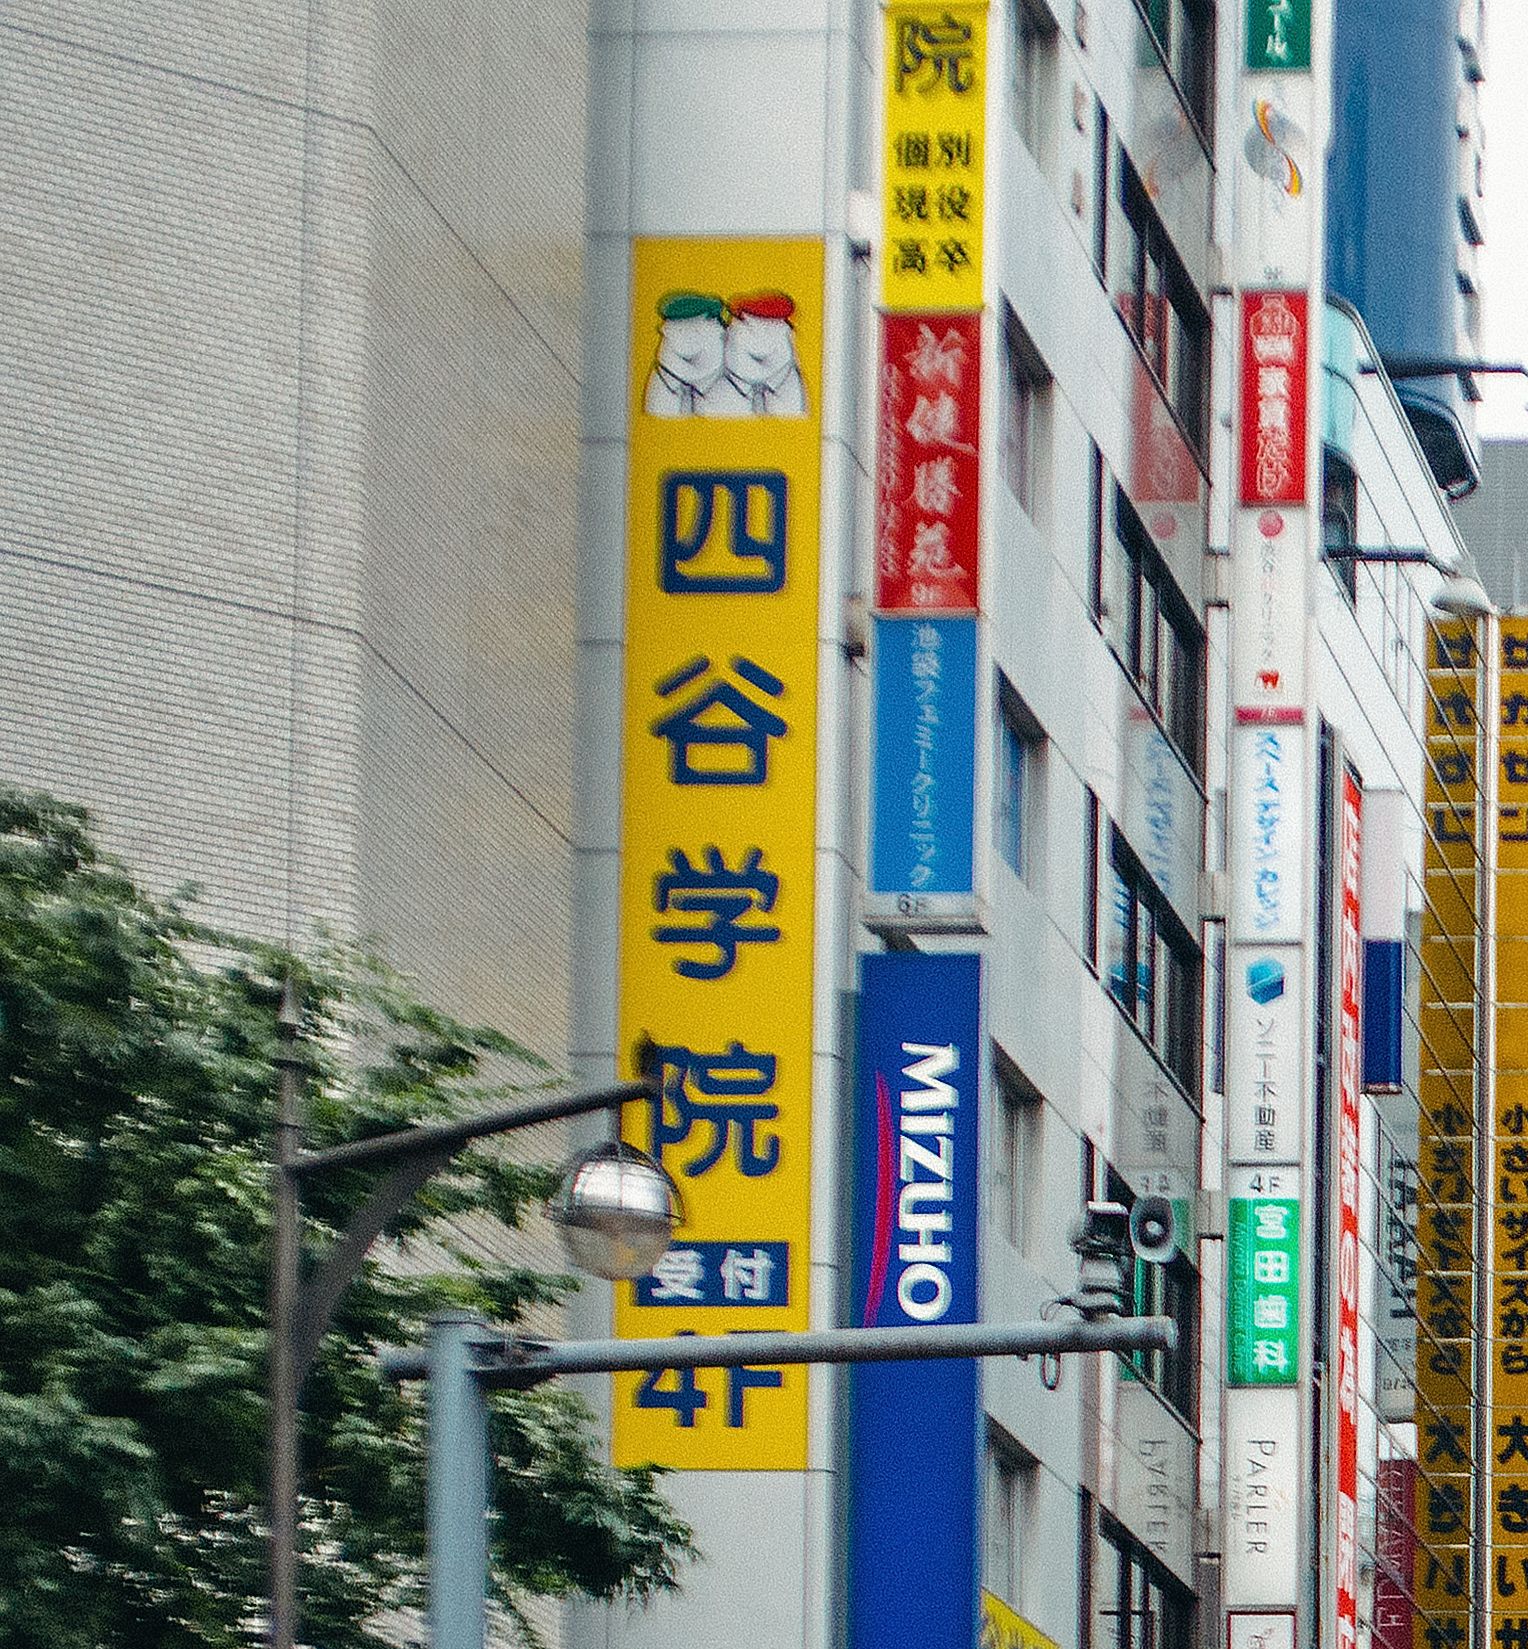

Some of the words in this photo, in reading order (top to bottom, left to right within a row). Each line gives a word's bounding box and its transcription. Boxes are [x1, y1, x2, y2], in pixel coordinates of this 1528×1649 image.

[893, 131, 973, 169] 個別
[893, 184, 972, 222] 現役
[892, 237, 971, 276] 高卒
[648, 468, 791, 1180] 四谷学院
[896, 1039, 961, 1324] MIZUHO
[1245, 1437, 1279, 1556] PARLER
